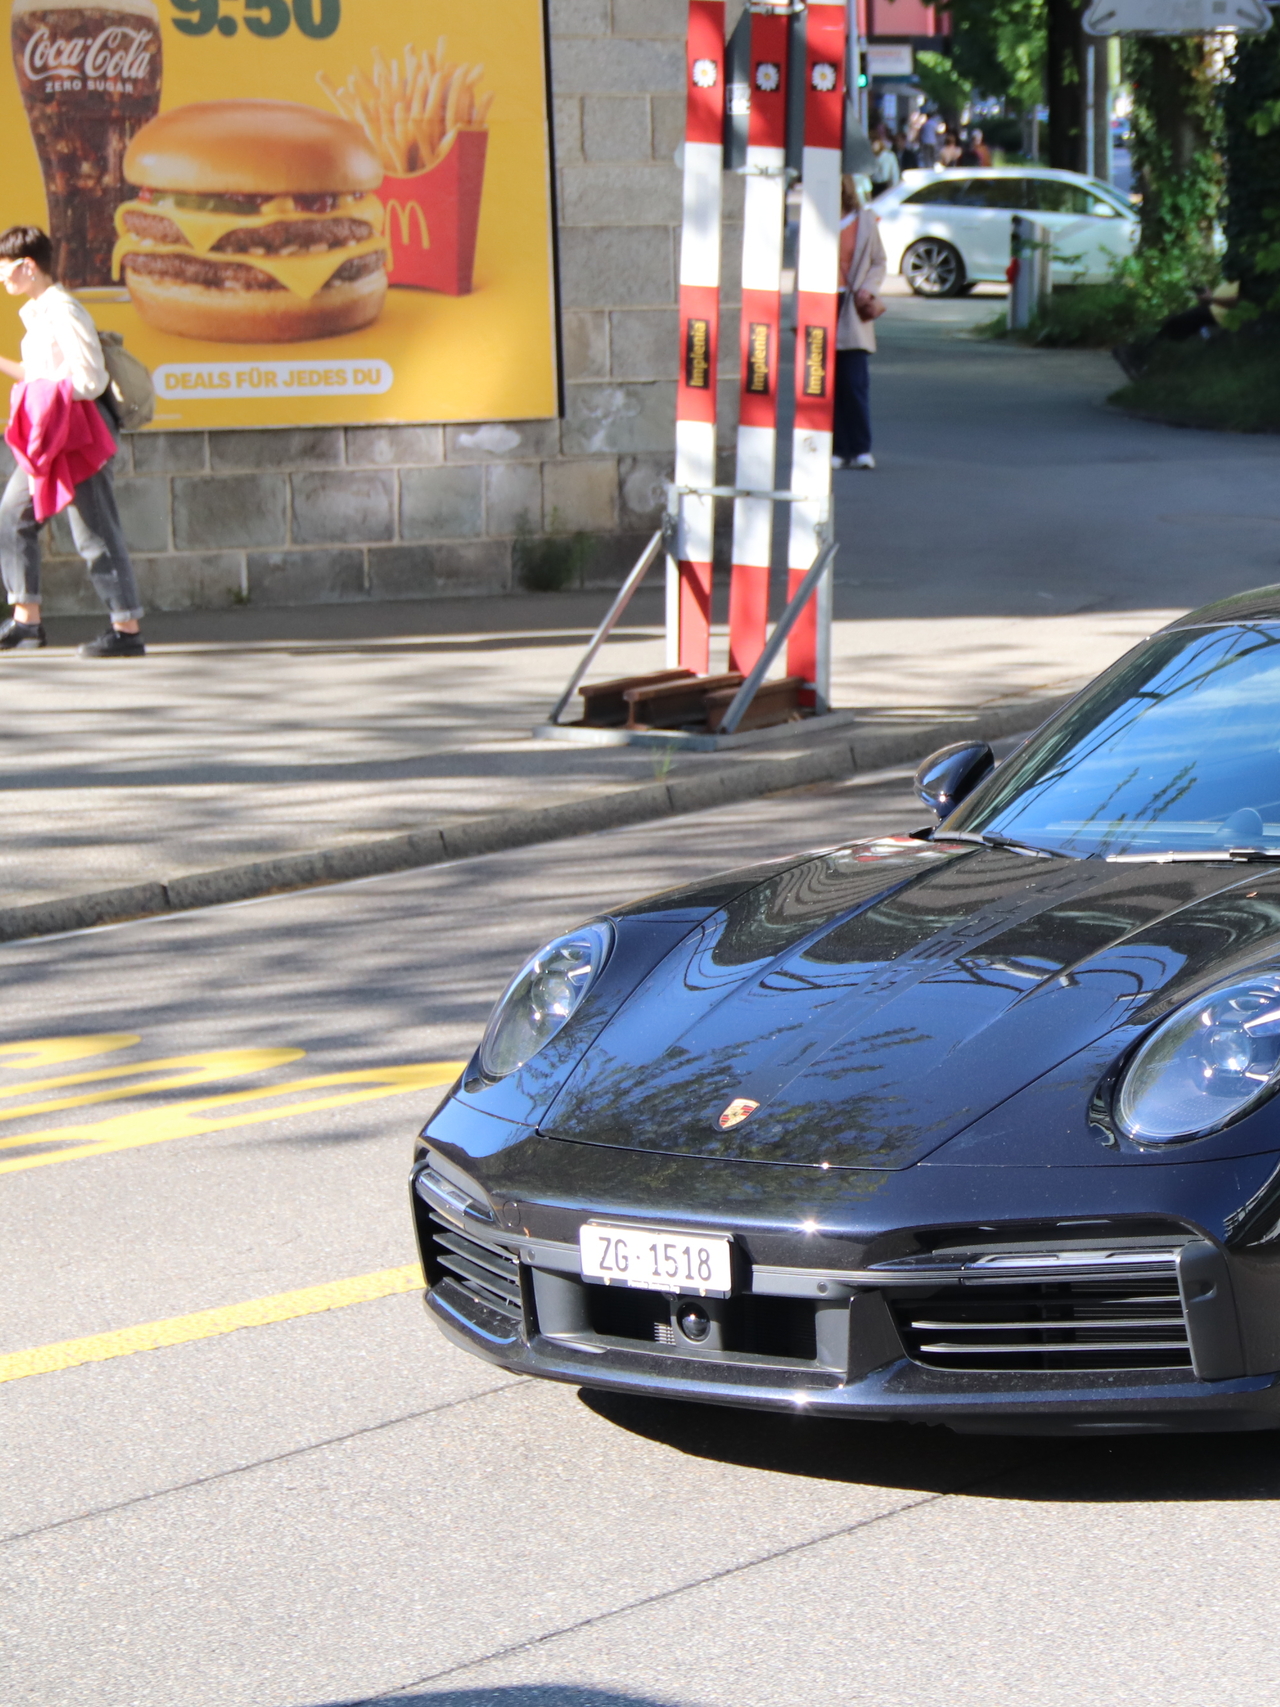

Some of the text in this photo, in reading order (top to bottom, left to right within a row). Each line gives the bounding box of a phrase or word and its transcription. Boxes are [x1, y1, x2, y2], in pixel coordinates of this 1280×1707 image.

[45, 79, 133, 93] ZERO SUGAR
[164, 367, 382, 390] DEALS FÜR JEDES DU
[689, 319, 708, 386] Implenia
[751, 324, 768, 391] Implenia
[806, 327, 825, 394] Implenia
[598, 1236, 712, 1281] ZG 1518
